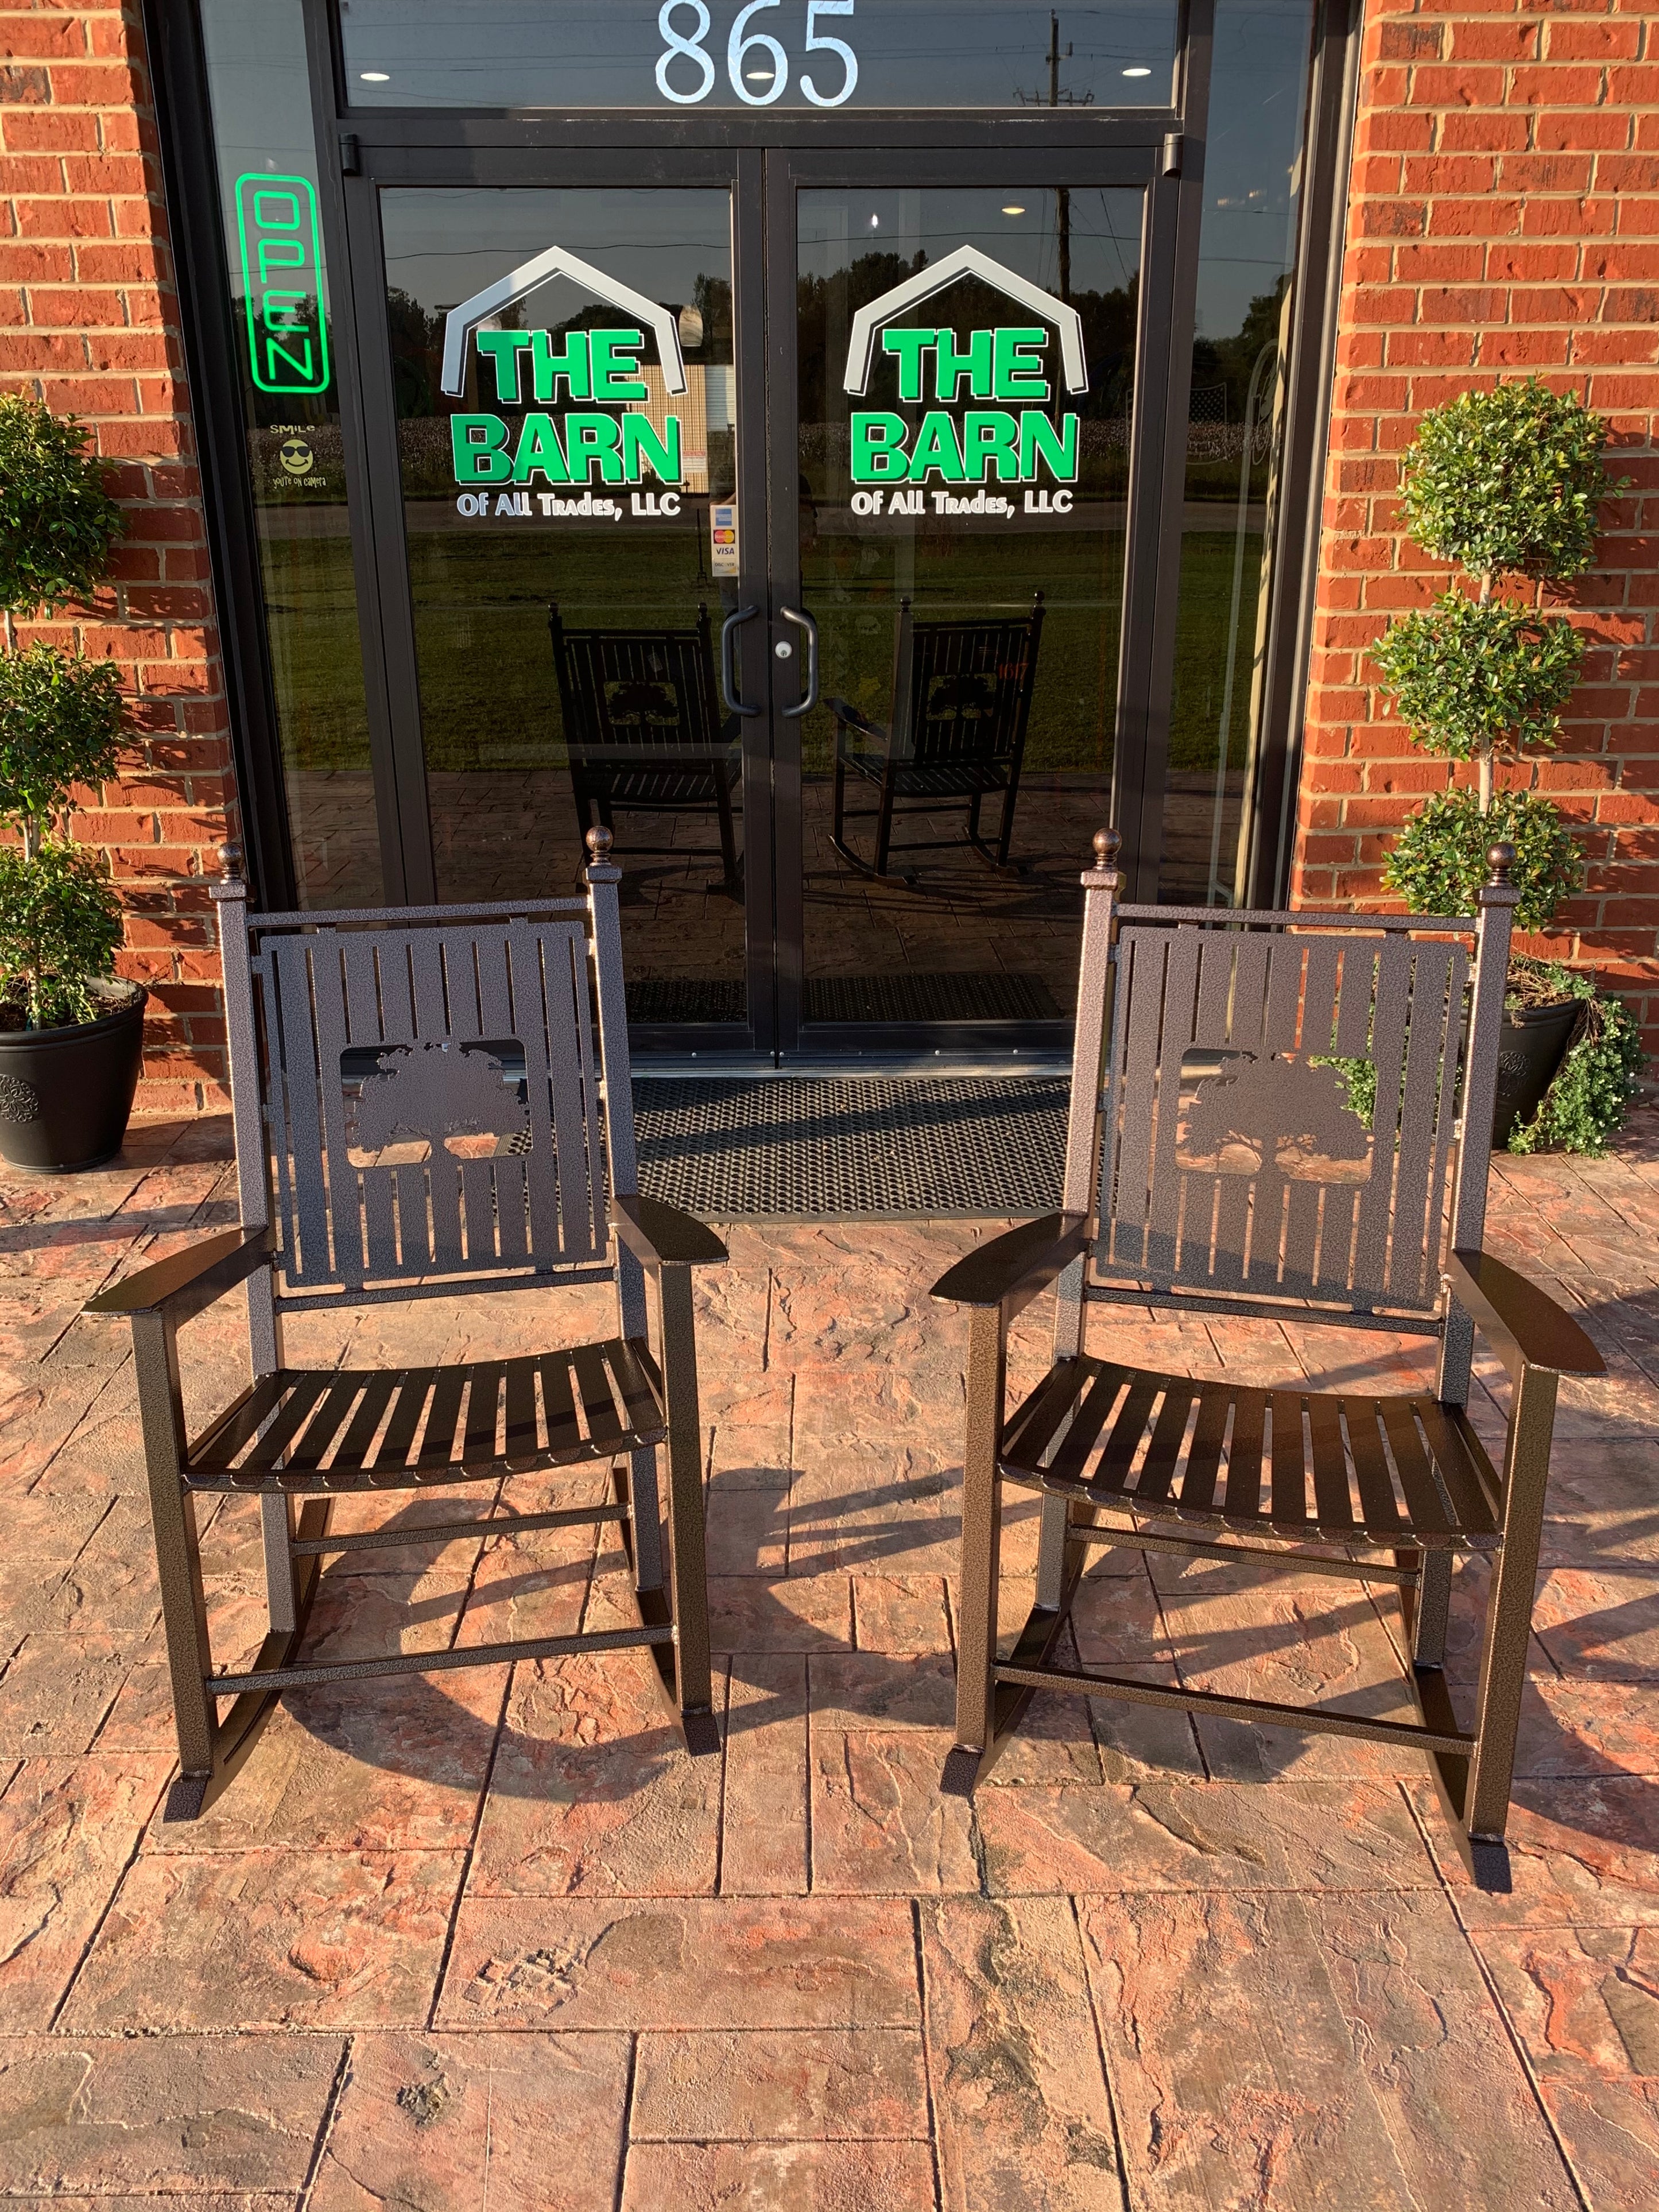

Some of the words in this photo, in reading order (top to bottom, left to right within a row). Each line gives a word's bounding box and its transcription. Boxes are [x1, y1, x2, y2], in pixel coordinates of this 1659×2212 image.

[655, 0, 858, 107] 865
[253, 190, 313, 381] OPEN
[476, 329, 649, 403] THE
[882, 327, 1051, 402] THE
[450, 413, 683, 485] BARN
[851, 410, 1080, 484] BARN
[457, 492, 489, 516] Of
[495, 492, 532, 516] All
[631, 492, 681, 516] LLC
[851, 491, 883, 515] Of
[888, 490, 925, 514] All
[1024, 489, 1073, 513] LLC
[716, 547, 735, 555] VISA
